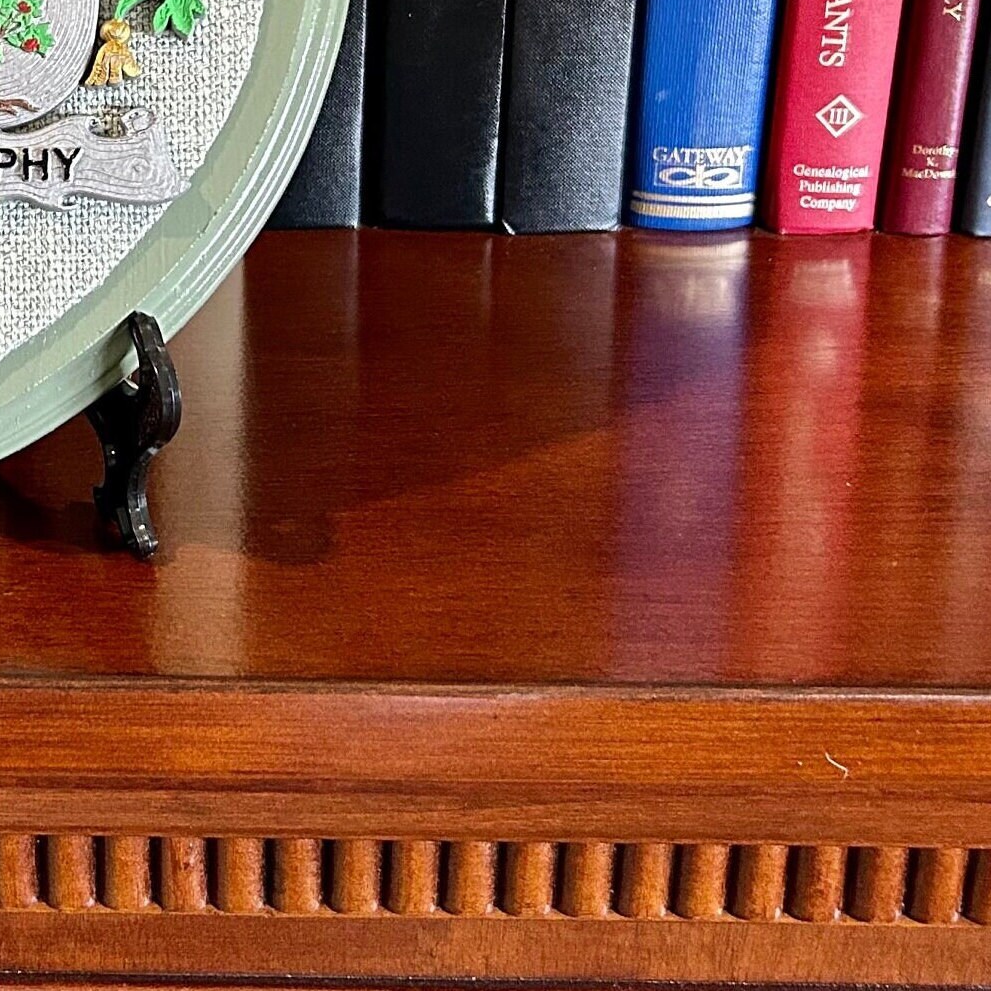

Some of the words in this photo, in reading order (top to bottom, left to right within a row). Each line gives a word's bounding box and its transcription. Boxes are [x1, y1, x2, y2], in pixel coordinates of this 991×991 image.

[653, 145, 751, 165] GATEWAY
[793, 164, 869, 180] Genealogical
[799, 180, 861, 196] Publishing
[800, 195, 856, 212] Company
